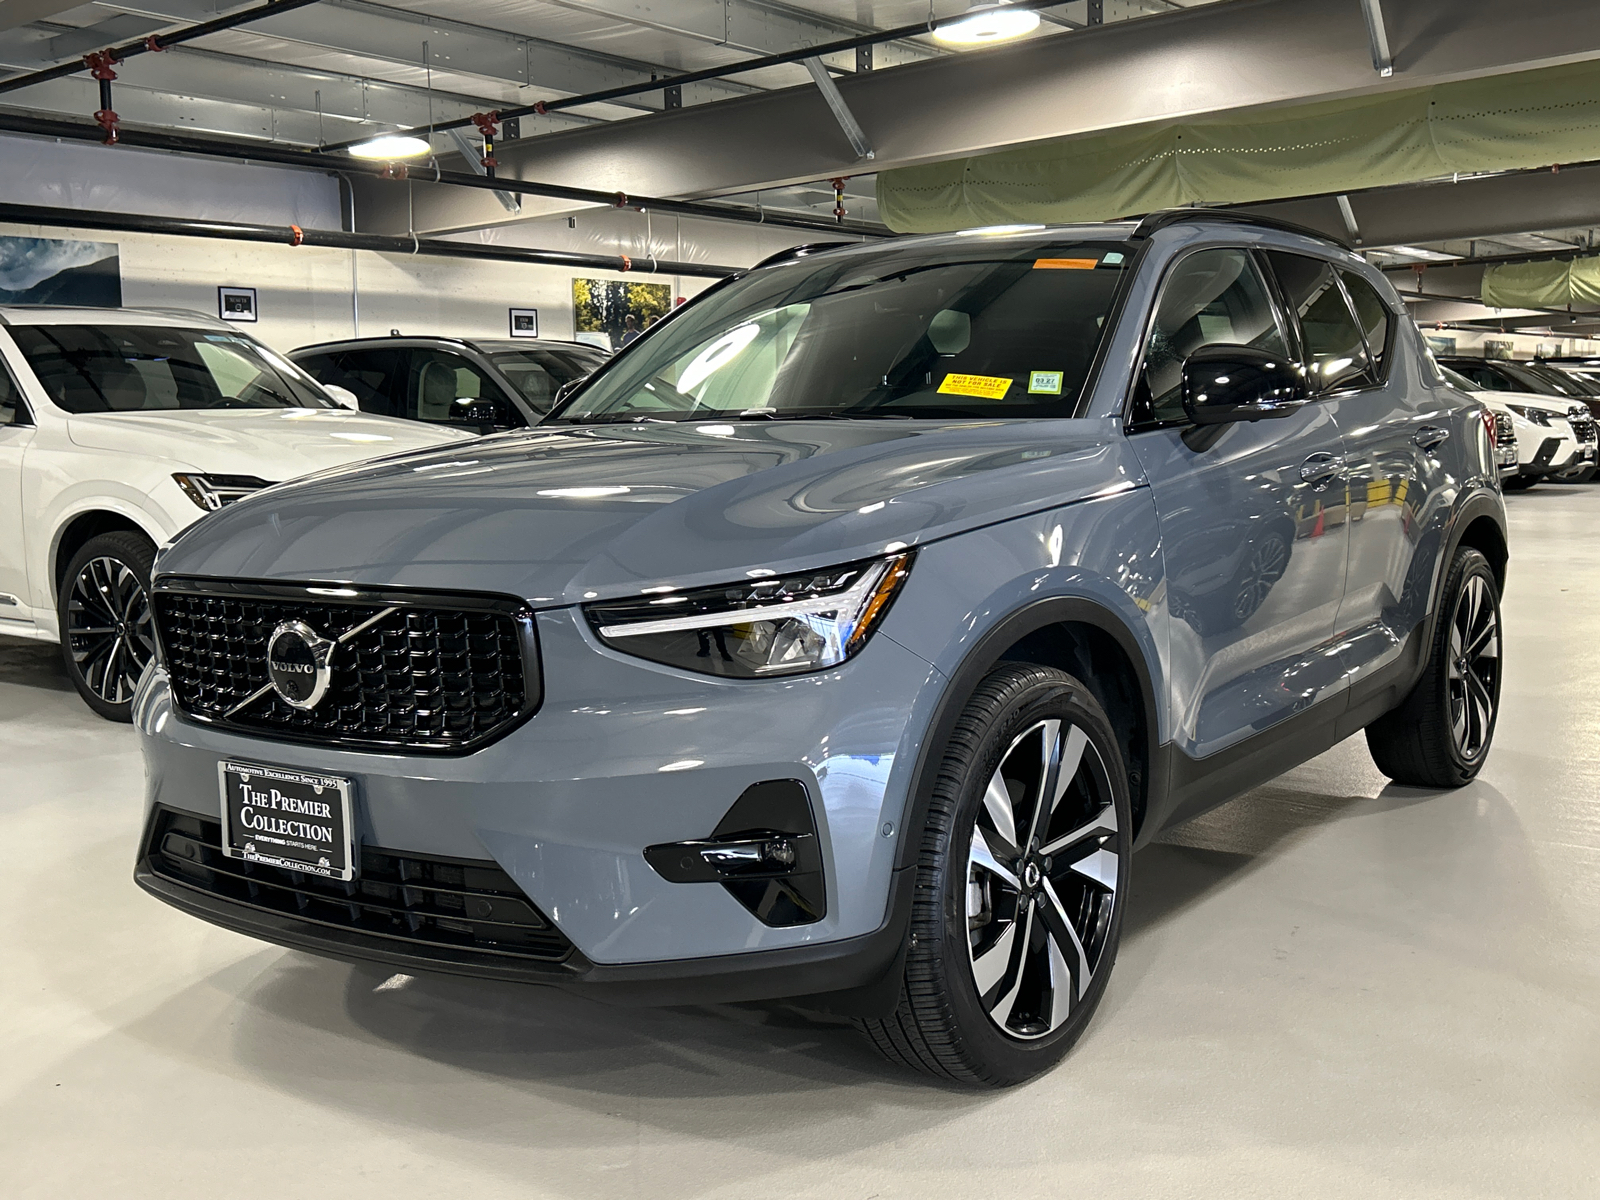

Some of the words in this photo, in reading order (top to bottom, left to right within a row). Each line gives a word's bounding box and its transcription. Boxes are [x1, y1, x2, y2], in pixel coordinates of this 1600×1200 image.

[271, 661, 314, 674] VOLVO
[227, 763, 263, 776] AUTOMOTIVE
[264, 769, 299, 782] EXCELLENCE
[301, 775, 319, 785] SINCE
[320, 778, 337, 788] 1995
[239, 783, 269, 808] THE
[270, 788, 332, 819] PREMIER
[240, 806, 332, 843] COLLECTION
[254, 834, 286, 846] EVERYTHING
[286, 840, 305, 849] STARTS
